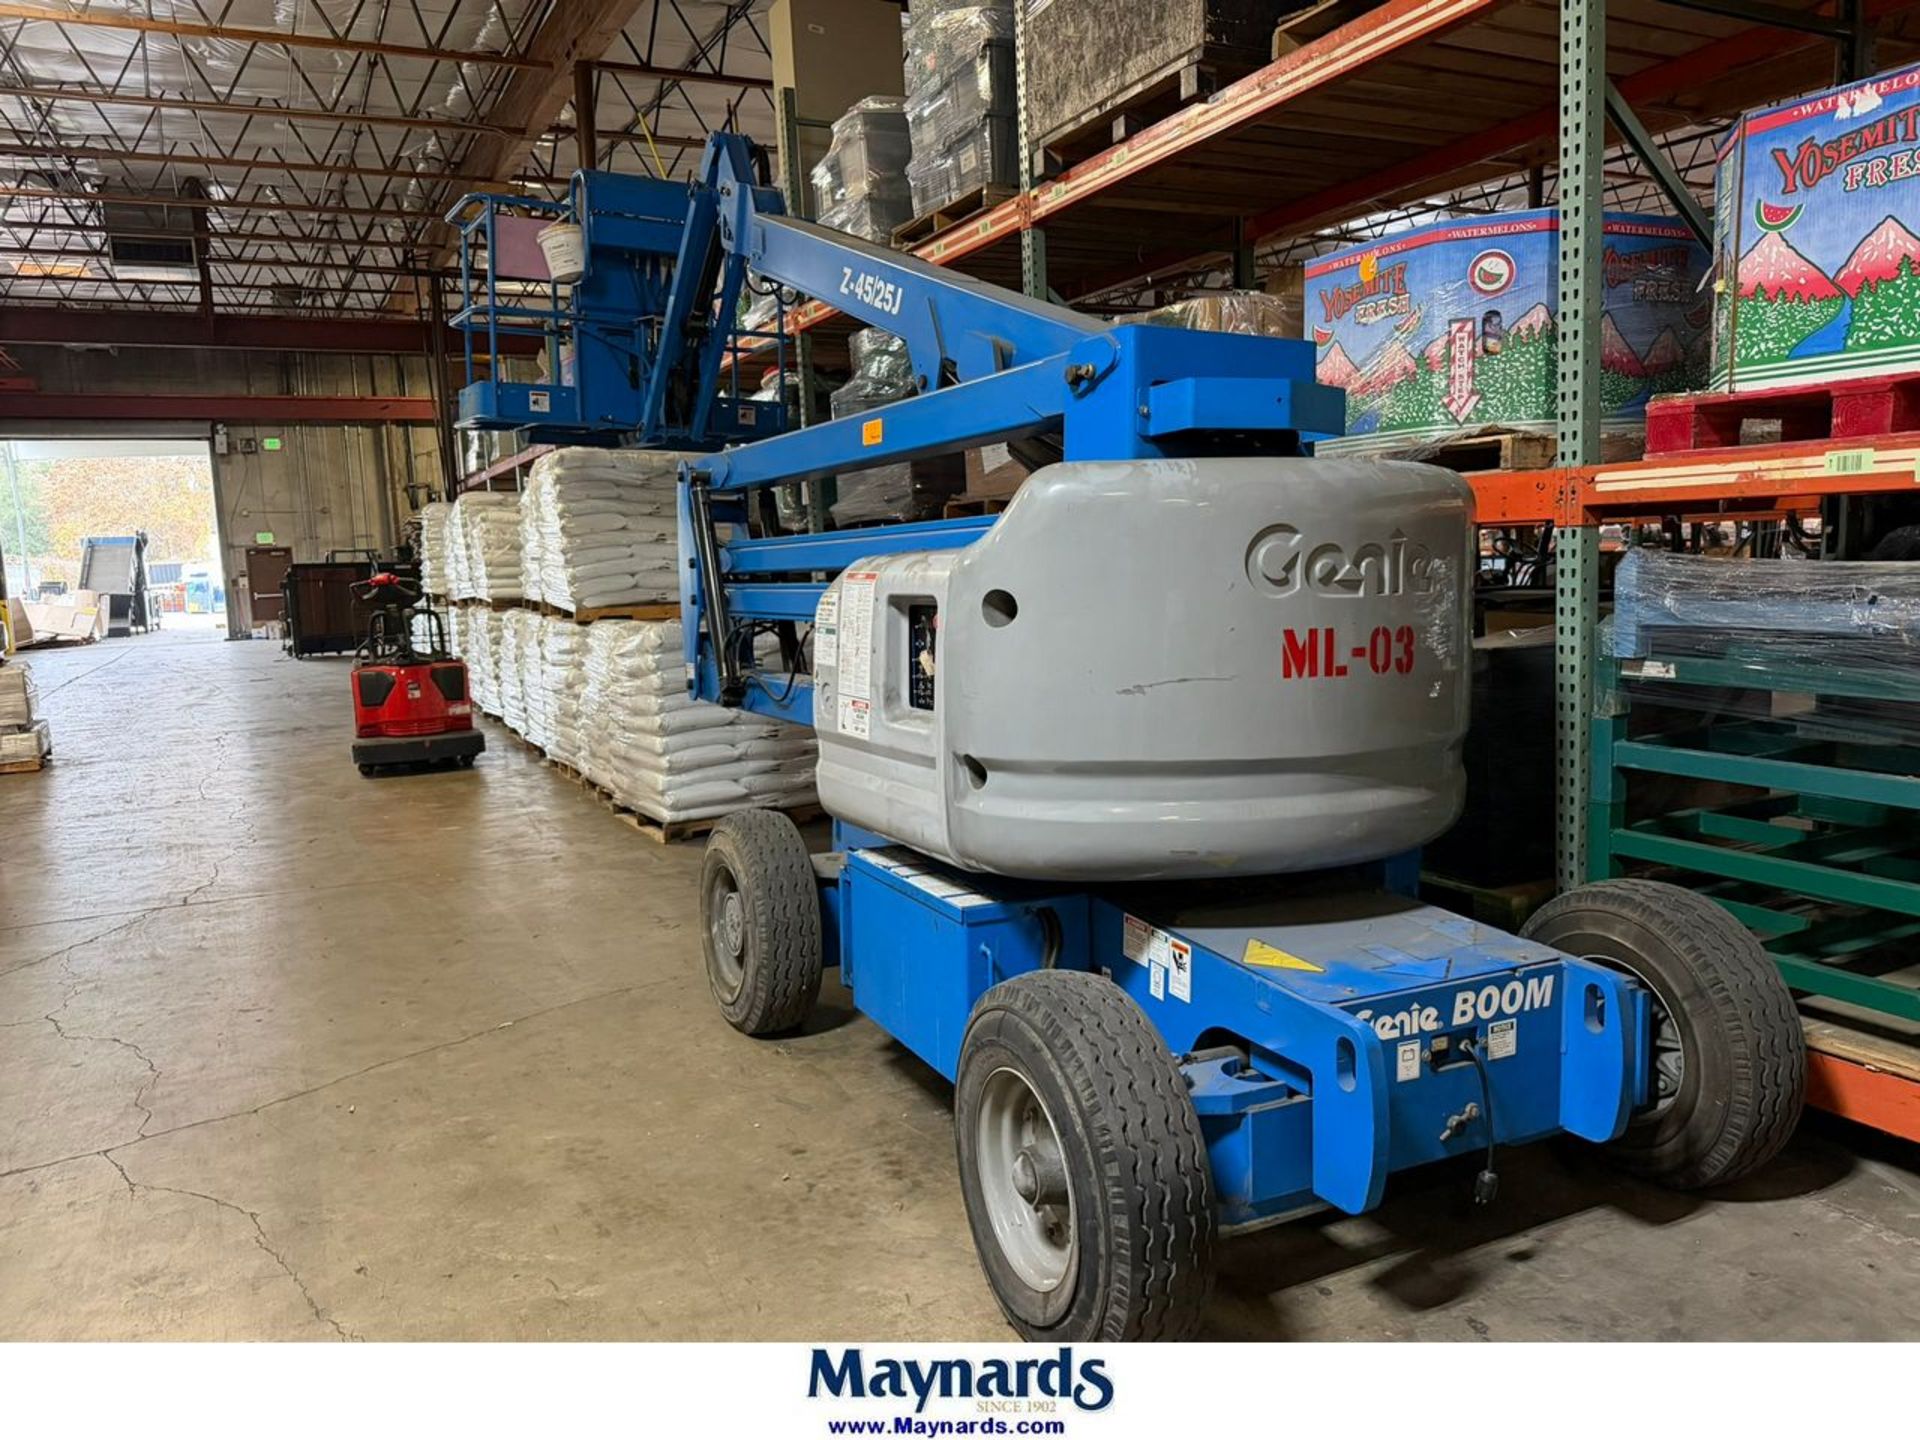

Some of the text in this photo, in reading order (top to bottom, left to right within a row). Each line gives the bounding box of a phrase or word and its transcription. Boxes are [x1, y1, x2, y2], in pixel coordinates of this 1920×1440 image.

[1452, 223, 1533, 238] WATERMELONS
[840, 266, 903, 315] Z-45/25J
[1282, 625, 1415, 680] ML-03
[1452, 974, 1554, 1026] BOOM
